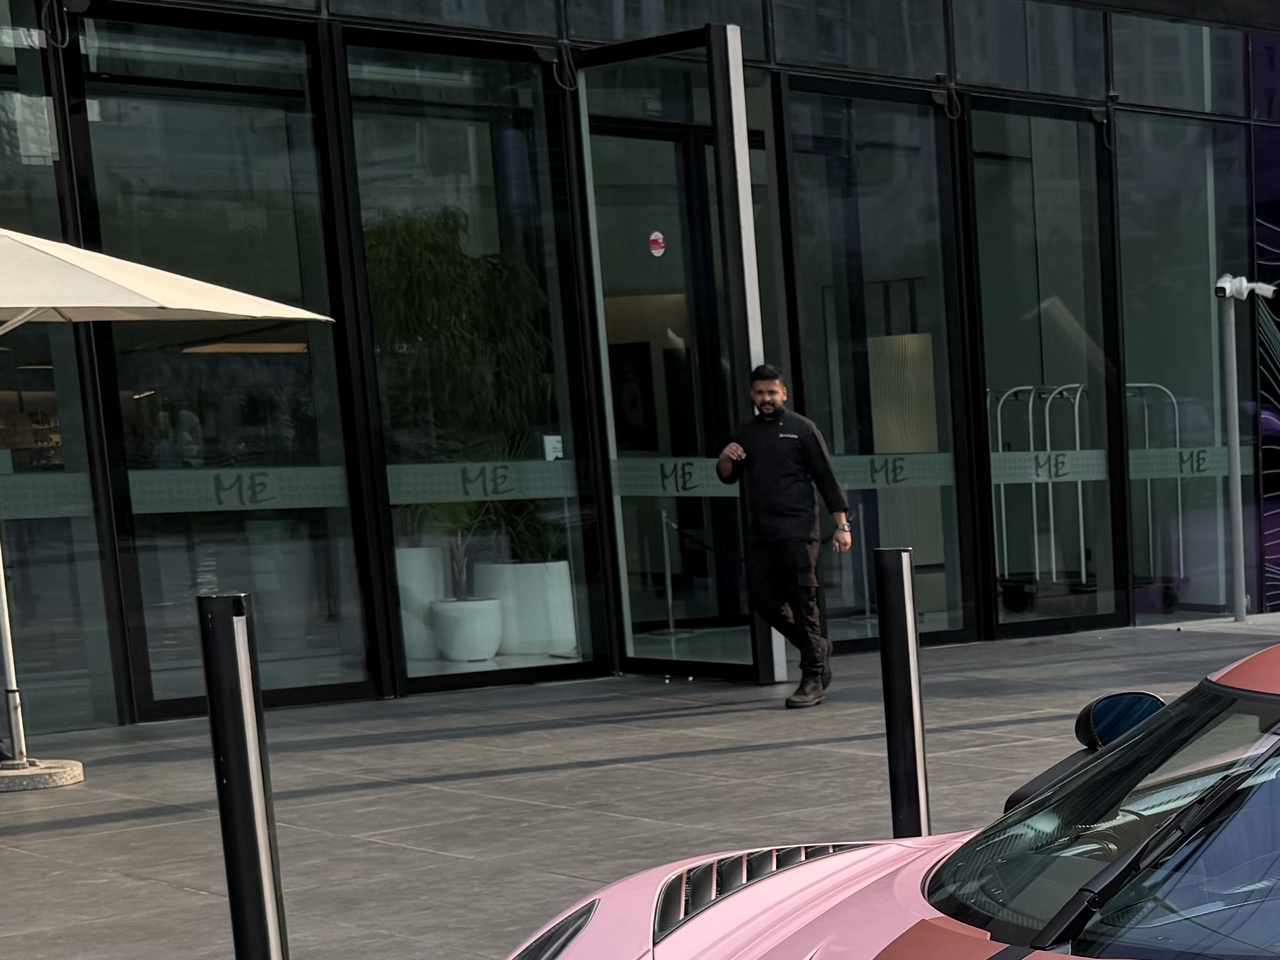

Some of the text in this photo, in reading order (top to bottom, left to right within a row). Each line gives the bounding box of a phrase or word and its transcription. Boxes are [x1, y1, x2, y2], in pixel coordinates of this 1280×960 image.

[870, 457, 909, 485] ME
[1034, 453, 1071, 479] ME
[1179, 450, 1211, 474] ME
[212, 472, 277, 507] ME
[460, 465, 516, 497] ME
[659, 462, 699, 493] ME
